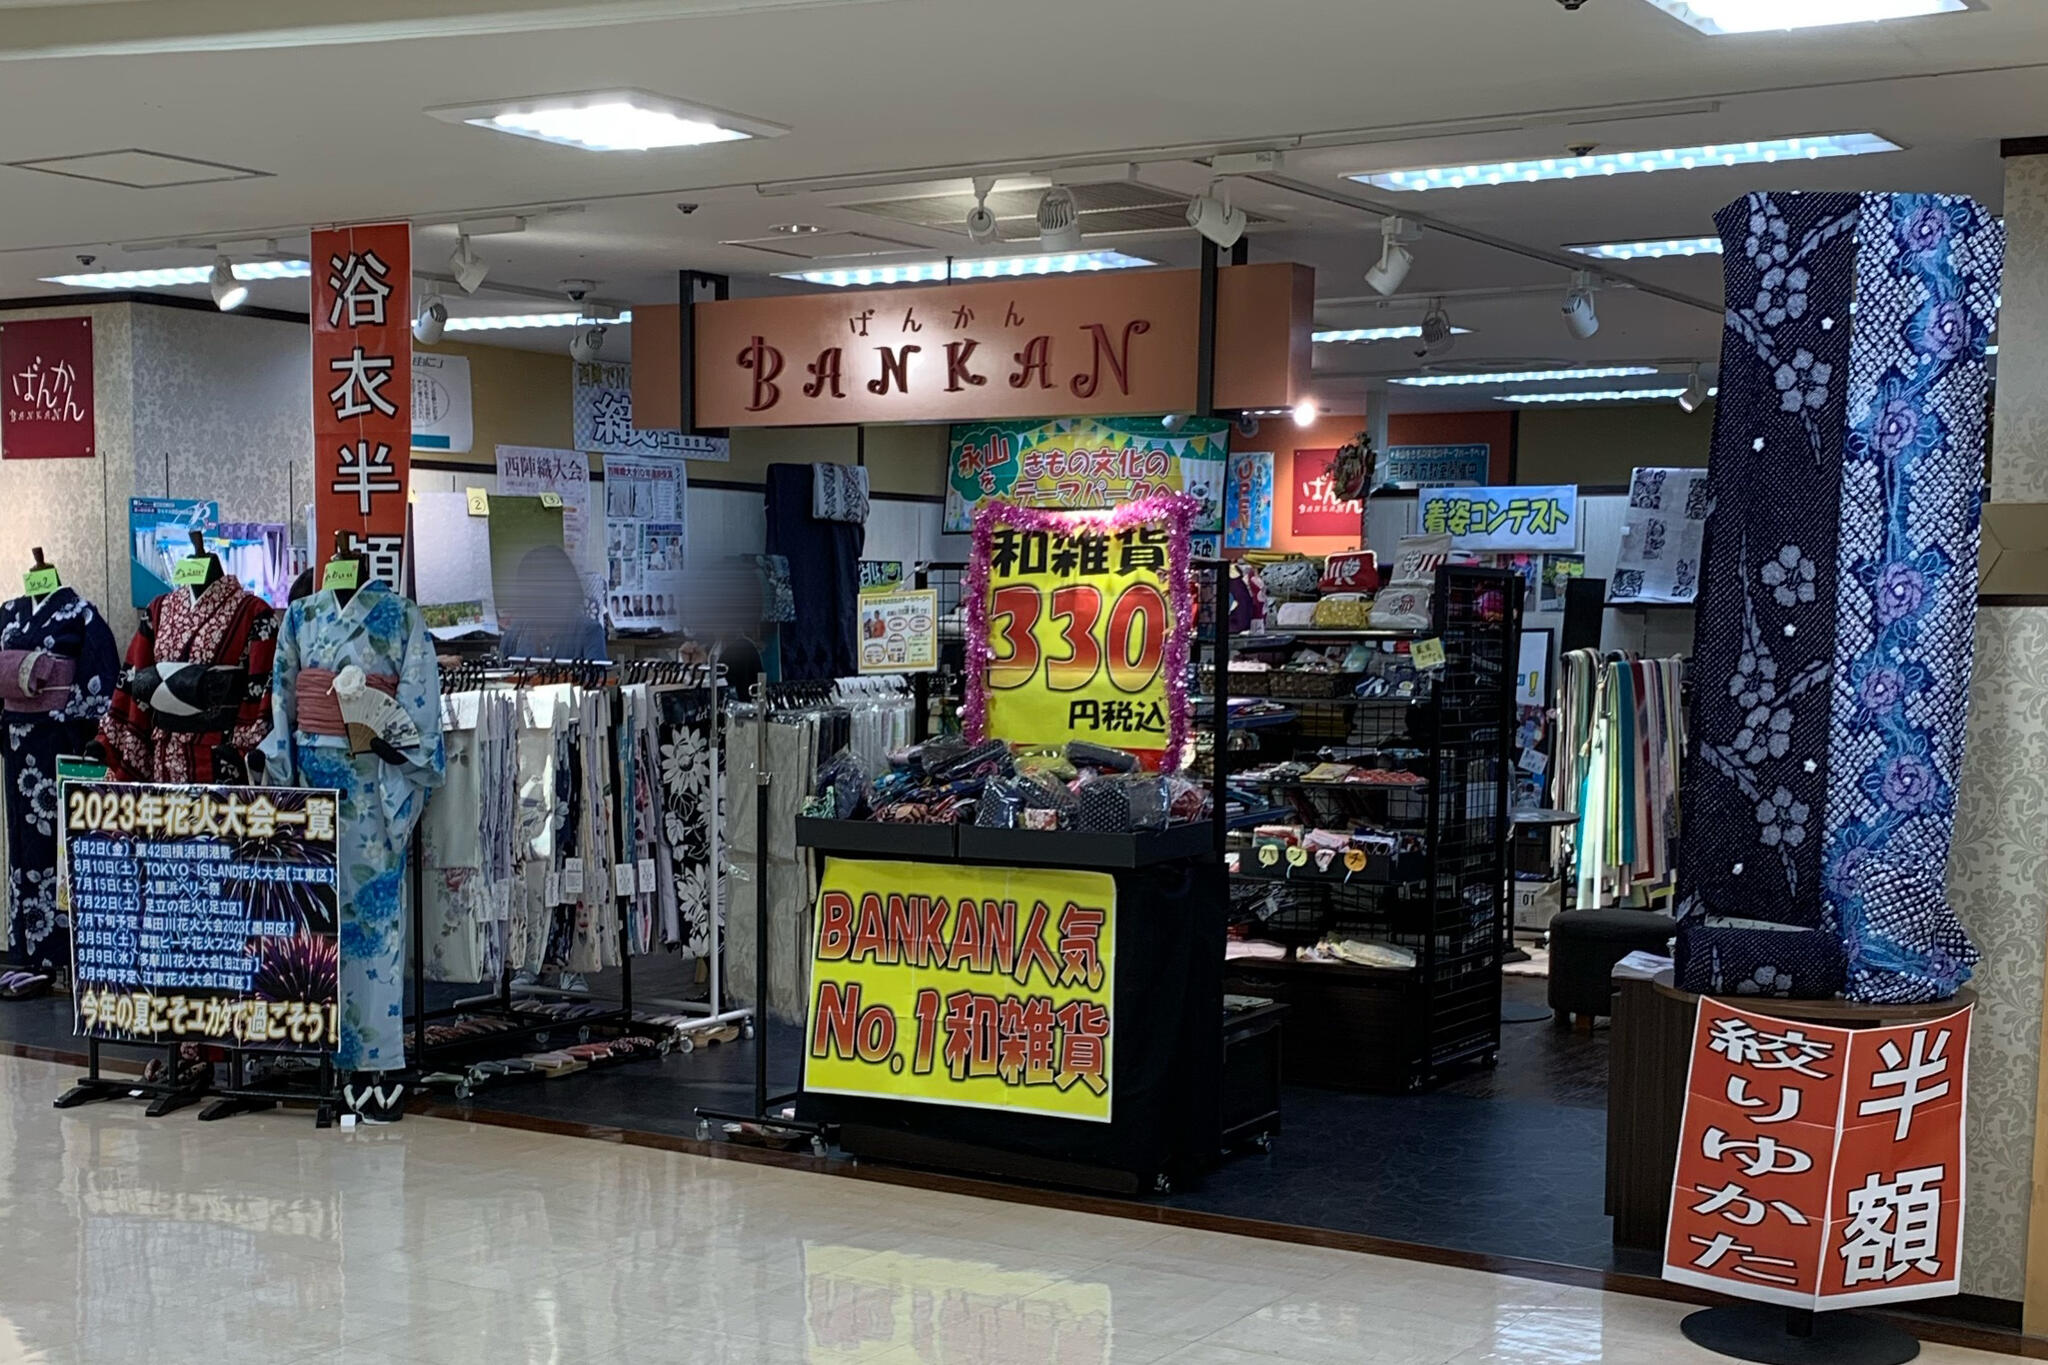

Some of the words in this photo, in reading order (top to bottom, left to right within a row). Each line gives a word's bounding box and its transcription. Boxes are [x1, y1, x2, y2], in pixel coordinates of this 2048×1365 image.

[849, 303, 1024, 337] ばんかん
[12, 355, 85, 422] ばんかん
[736, 320, 1150, 412] BANKAN
[9, 408, 61, 422] BANKAN
[959, 433, 1010, 477] 永山
[1023, 447, 1171, 481] きもの文化の
[1302, 472, 1363, 514] ばんん
[1424, 498, 1569, 536] 着姿コンテスト
[992, 529, 1170, 578] 和雑貨
[987, 583, 1168, 693] 330
[1069, 698, 1167, 733] 円税込
[69, 791, 334, 841] 2023年花火大会一覧
[816, 891, 1104, 991] BANKAN人気
[81, 991, 337, 1043] 今年の夏こそユカタで過ごそう！
[811, 982, 1110, 1096] No.1和雑貨
[1687, 1017, 1835, 1285] 絞りゆかた
[1838, 1028, 1952, 1288] 半額
